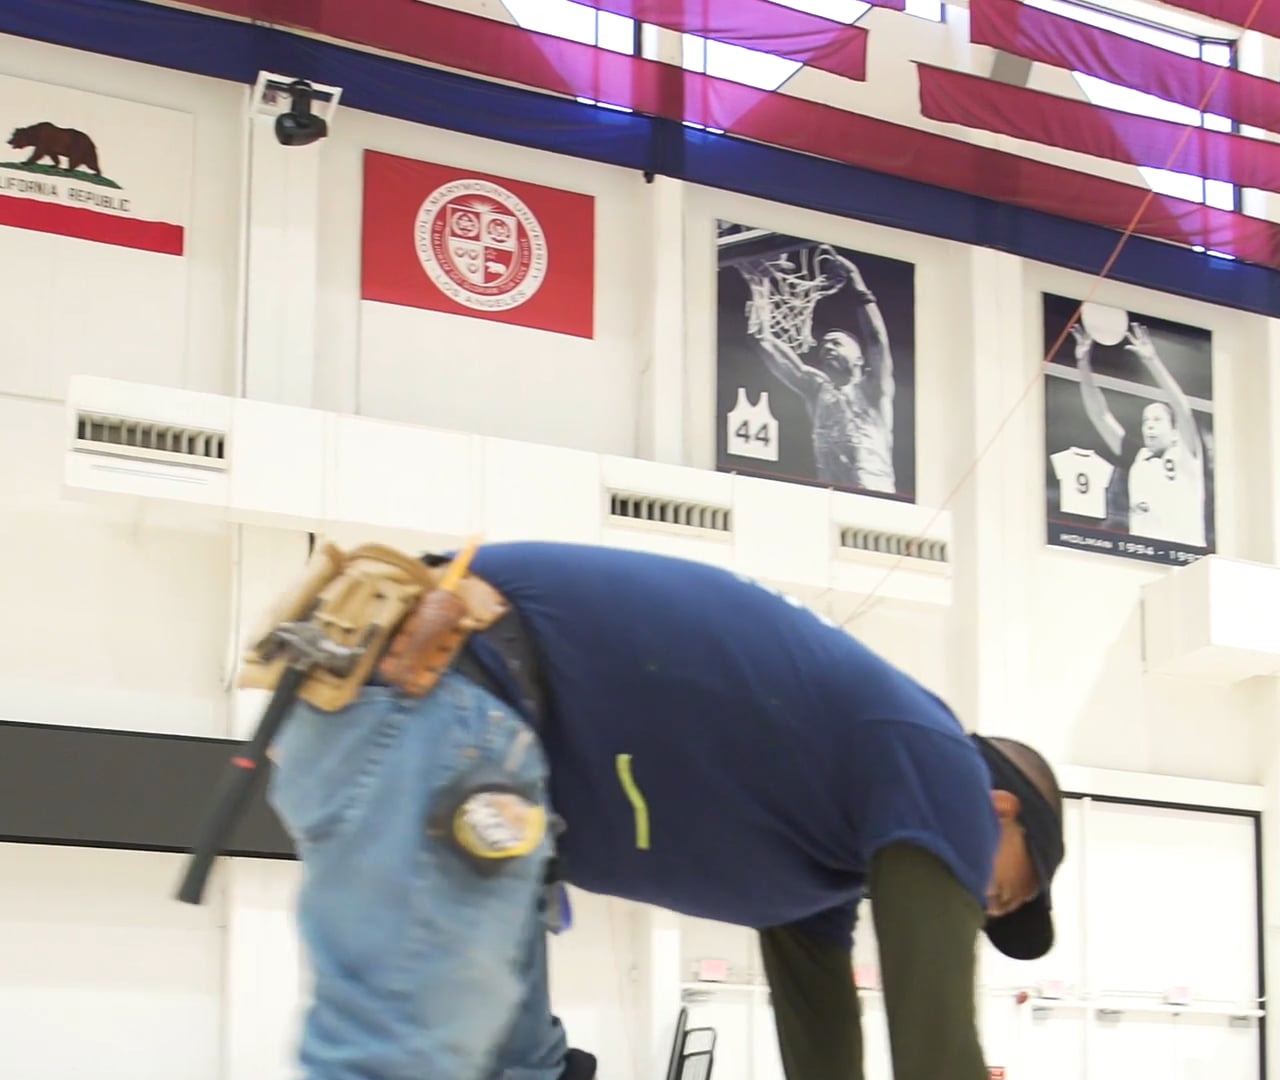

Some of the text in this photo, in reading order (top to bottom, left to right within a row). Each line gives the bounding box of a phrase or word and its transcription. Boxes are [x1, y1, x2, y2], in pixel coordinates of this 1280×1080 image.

[68, 187, 130, 212] REPUBLIC
[419, 206, 433, 263] LOYOLA
[429, 183, 513, 205] MARYMOUNT
[515, 203, 543, 279] UNIVERSITY
[434, 274, 527, 308] LOS ANGELES
[735, 419, 770, 447] 44
[1164, 458, 1176, 481] 9
[1076, 473, 1089, 494] 9
[1118, 542, 1155, 555] 1994
